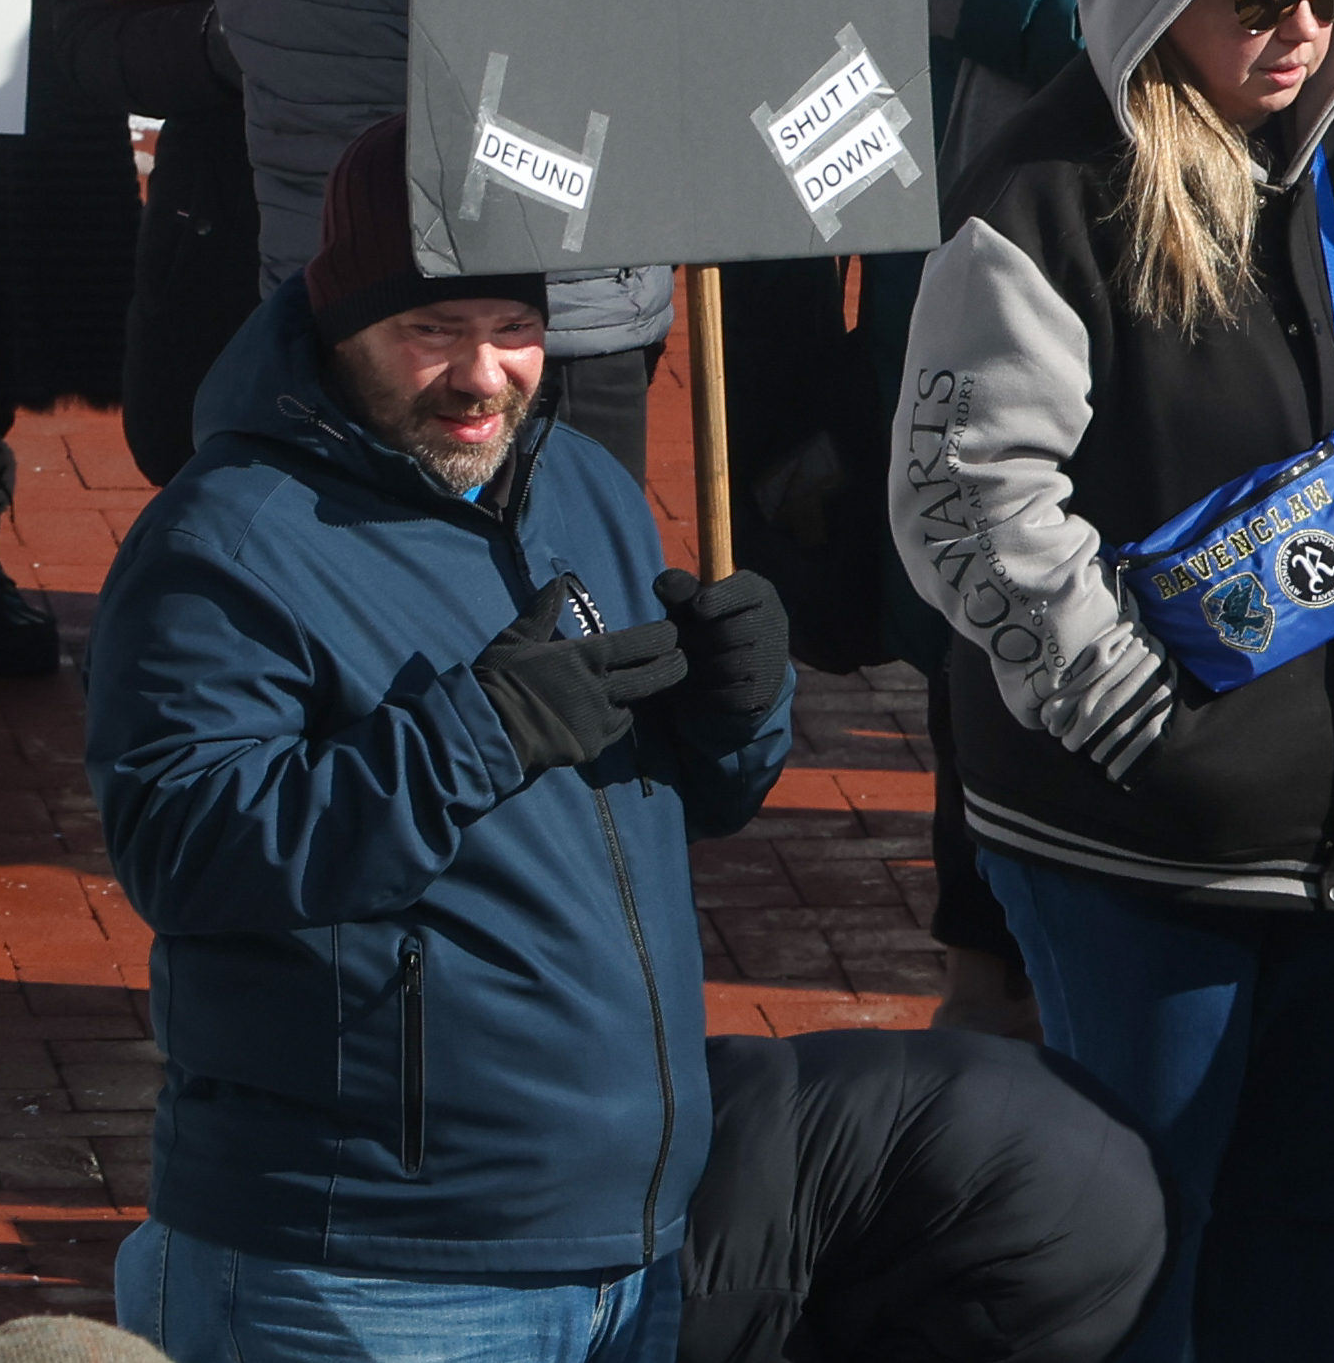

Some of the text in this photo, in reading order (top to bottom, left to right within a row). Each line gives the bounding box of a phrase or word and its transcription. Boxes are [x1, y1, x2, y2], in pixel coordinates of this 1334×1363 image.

[779, 62, 872, 151] SHUT IT
[482, 133, 585, 197] DEFUND
[804, 128, 892, 202] DOWN!
[946, 375, 975, 475] WIZARDRY
[906, 368, 1052, 714] HOGWARTS
[1152, 478, 1333, 600] RAVENCLAW
